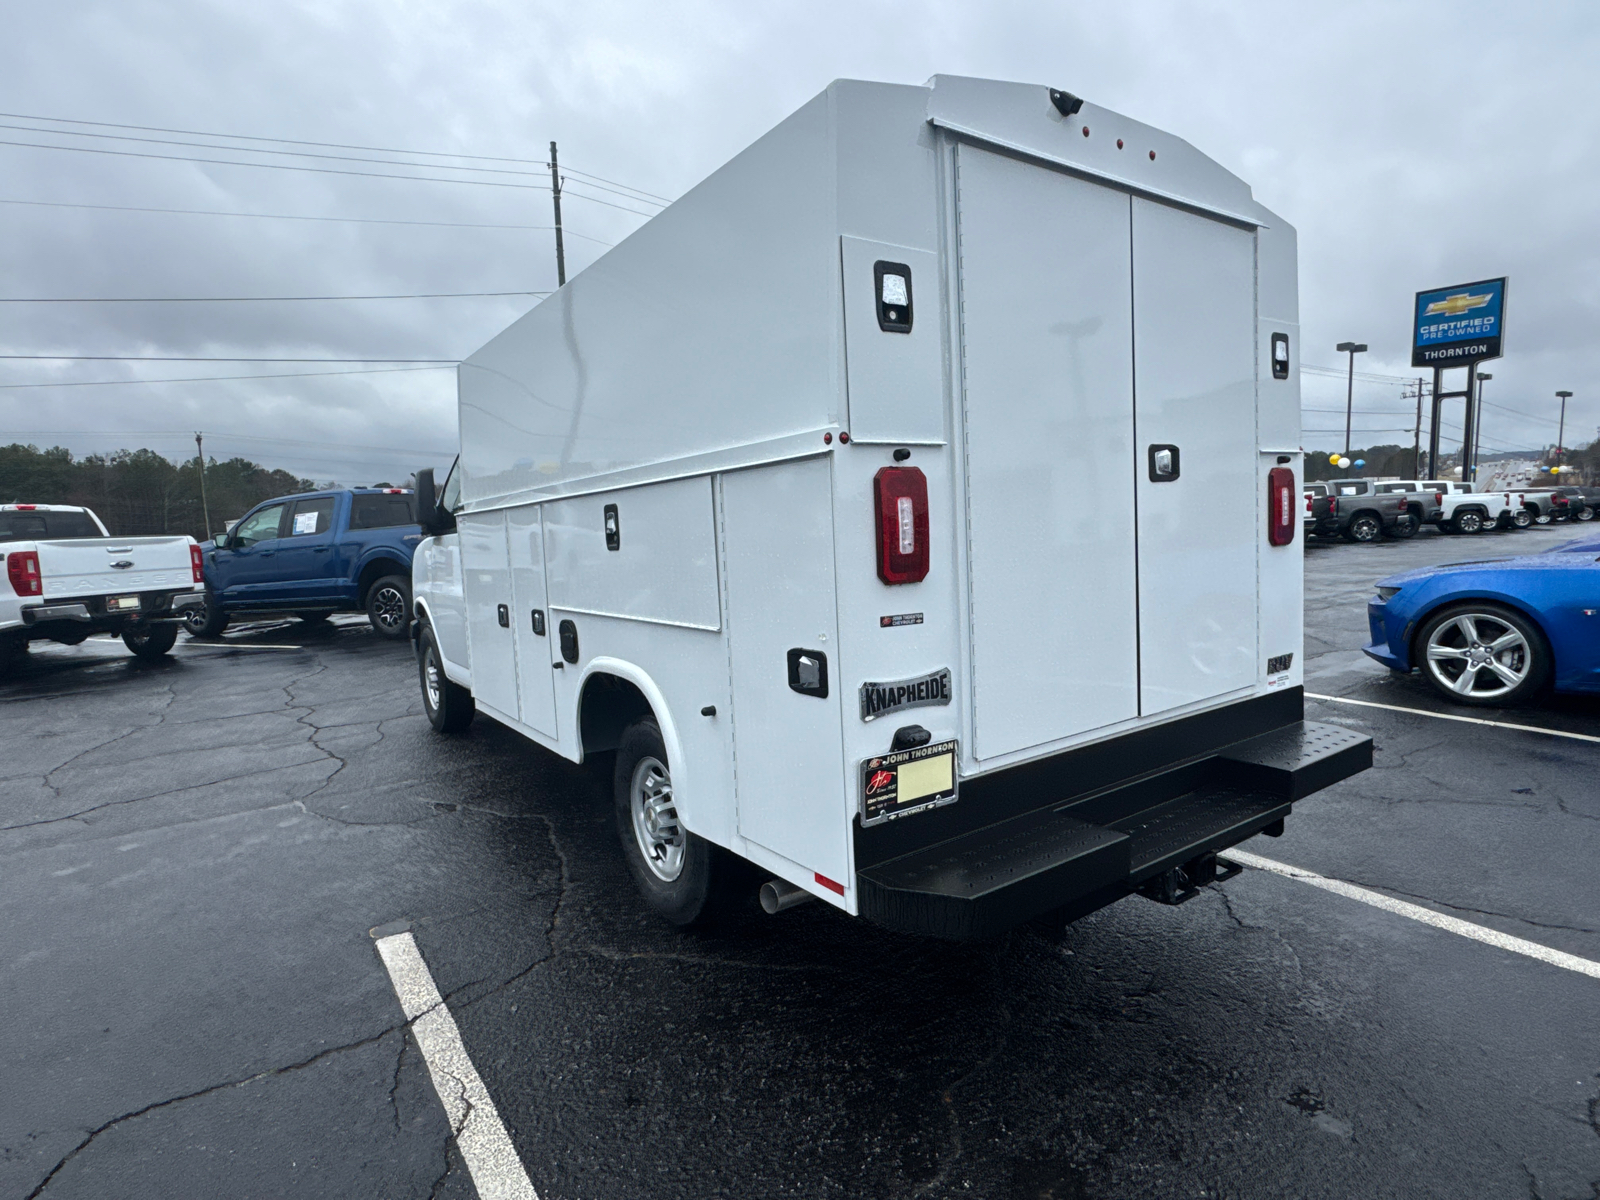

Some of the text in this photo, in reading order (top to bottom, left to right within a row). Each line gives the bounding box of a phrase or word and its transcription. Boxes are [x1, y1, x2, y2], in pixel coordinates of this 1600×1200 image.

[1420, 316, 1495, 334] CERTIFIED
[1423, 325, 1490, 340] PRE-OWNED
[1424, 344, 1487, 360] THORNTON
[48, 573, 190, 592] RANGER
[865, 673, 949, 715] KNAPHEIDE
[885, 753, 910, 765] JOHN
[911, 742, 954, 758] THORNTON
